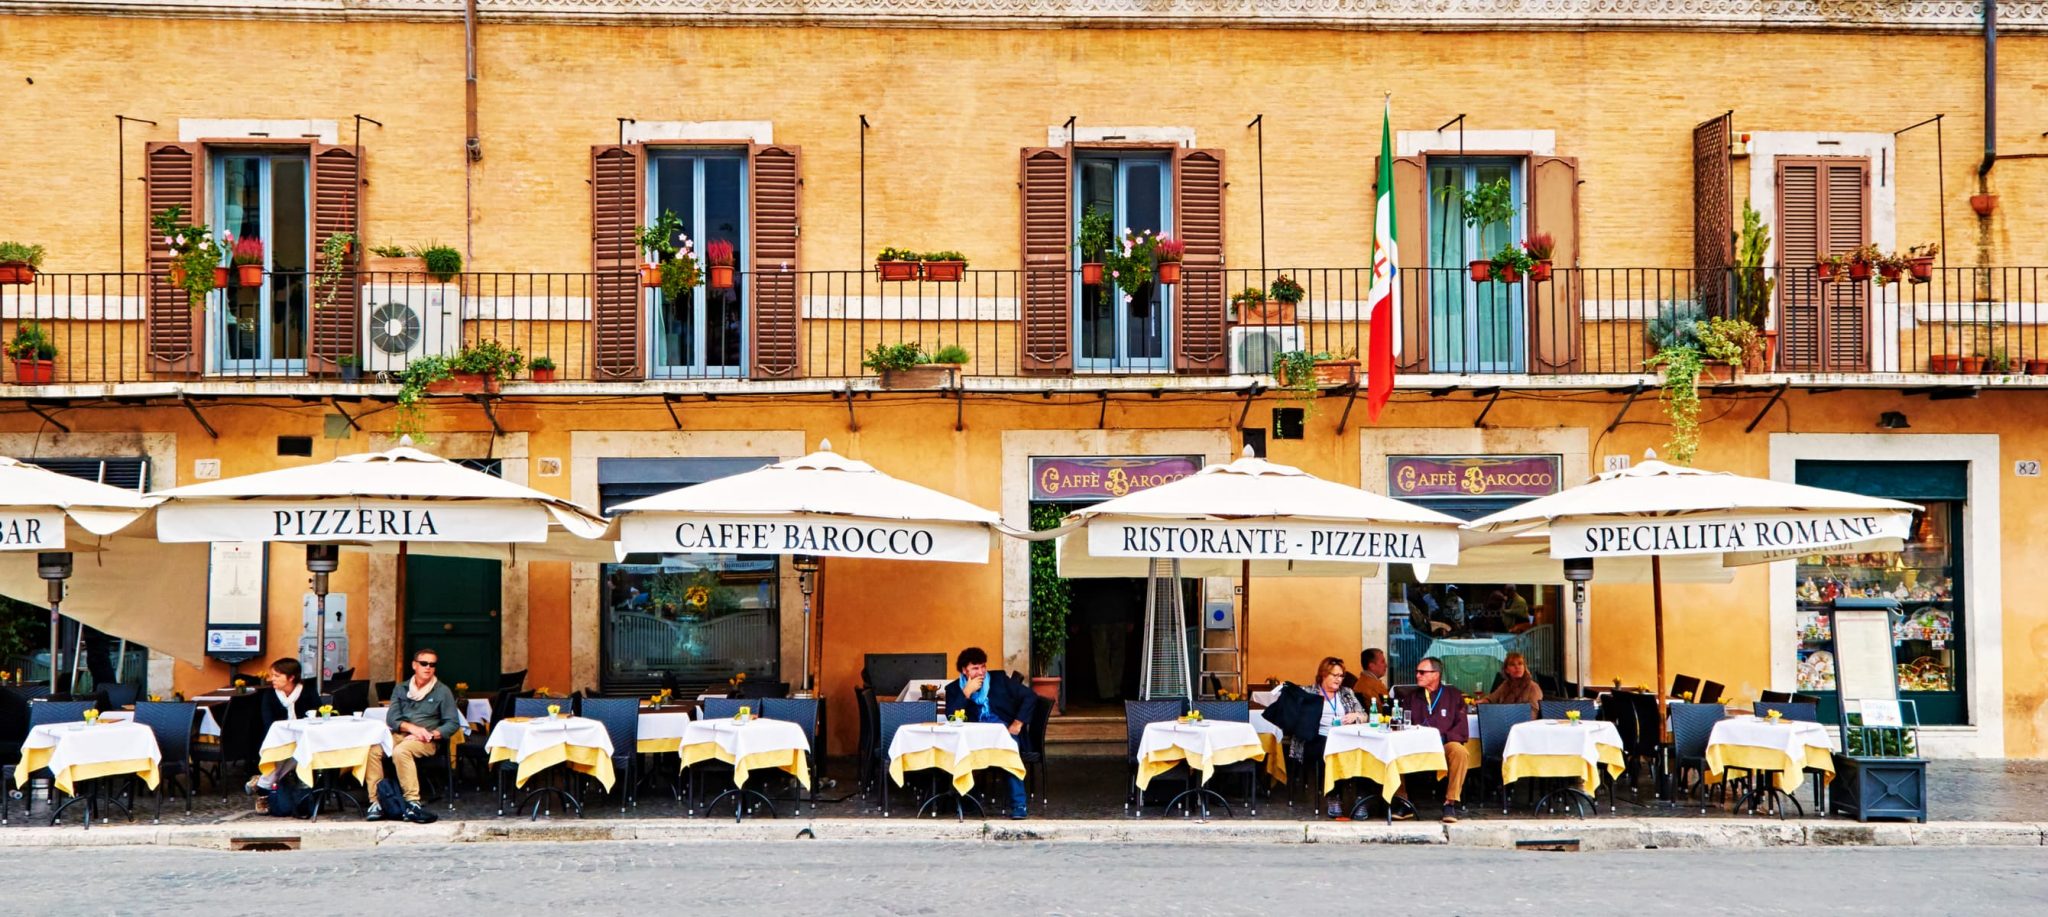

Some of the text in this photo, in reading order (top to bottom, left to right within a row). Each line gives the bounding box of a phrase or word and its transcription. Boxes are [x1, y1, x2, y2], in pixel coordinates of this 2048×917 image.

[1460, 466, 1552, 494] BAROCCO
[2018, 461, 2037, 475] 82
[272, 509, 438, 536] PIZZERIA
[1755, 516, 1883, 547] ROMANE
[784, 524, 934, 556] BAROCCO
[1122, 526, 1288, 555] RISTORANTE
[1311, 530, 1427, 559] PIZZERIA
